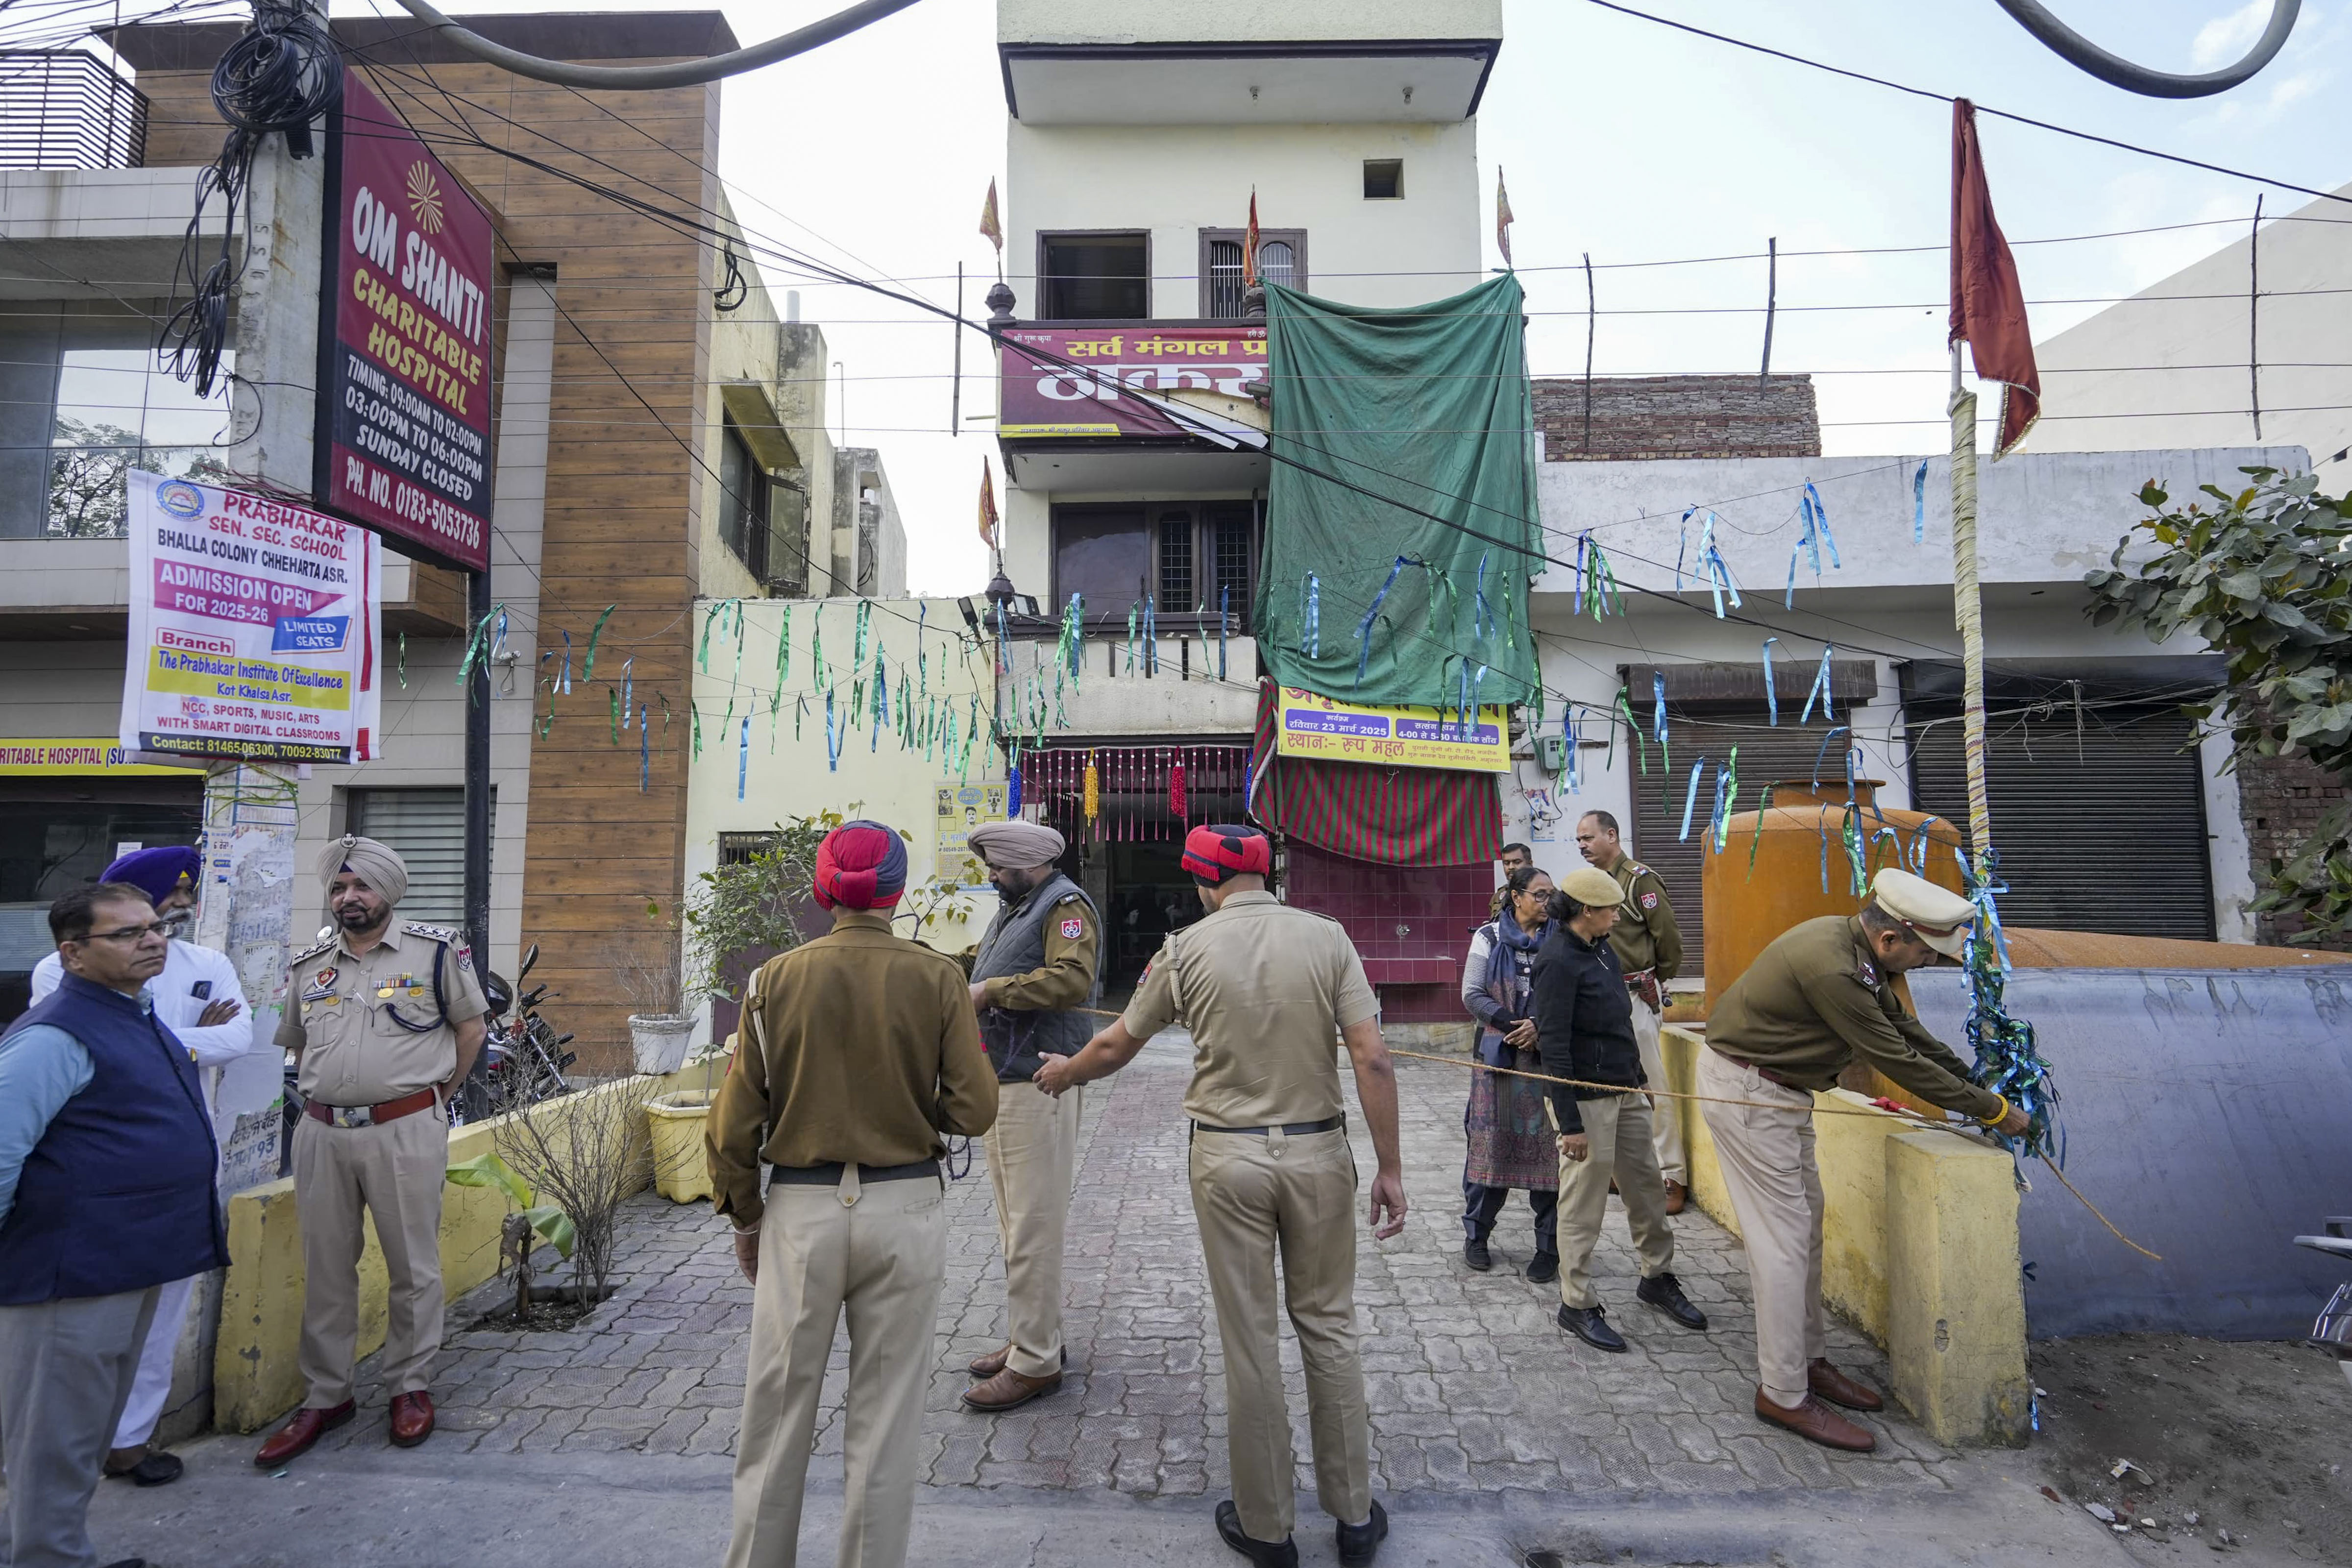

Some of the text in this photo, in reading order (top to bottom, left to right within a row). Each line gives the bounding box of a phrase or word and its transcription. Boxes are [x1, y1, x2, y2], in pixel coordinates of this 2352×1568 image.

[353, 186, 484, 346] OM SHANTI
[353, 269, 482, 385] CHARITABLE
[1065, 336, 1124, 356] सर्व
[1134, 335, 1229, 356] मंगल
[368, 322, 466, 415] HOSPITAL
[348, 354, 482, 456] TIMING: 09:00AM TO 02:00PM
[346, 386, 482, 482] 03:00PM TO 06:00PM
[357, 425, 472, 501] SUNDAY CLOSED
[224, 492, 347, 542] PRABHAKAR
[346, 456, 480, 549] PH. NO. 0183-5053736
[209, 516, 347, 561] SEN. SEC. SCHOOL
[158, 529, 347, 583] BHALLA COLONY CHHEHARTA ASR.
[160, 563, 312, 611] ADMISSION OPEN
[175, 592, 269, 622] FOR 2025-26
[162, 631, 231, 653] Branch
[284, 621, 337, 634] LIMITED
[296, 636, 335, 647] SEATS
[159, 650, 343, 689] The Prabhakar Institute Of Excellence
[217, 682, 293, 702] Kot Khalsa Asr.
[157, 716, 340, 741] WITH SMART DIGITAL CLASSROOMS
[182, 701, 319, 724] NCC, SPORTS, MUSIC, ARTS
[1289, 719, 1387, 735] रविवार 23 मार्च 2025
[48, 748, 102, 764] HOSPITAL
[151, 735, 342, 759] Contact: 81465-06300, 70092-83077
[1372, 740, 1405, 757] महल
